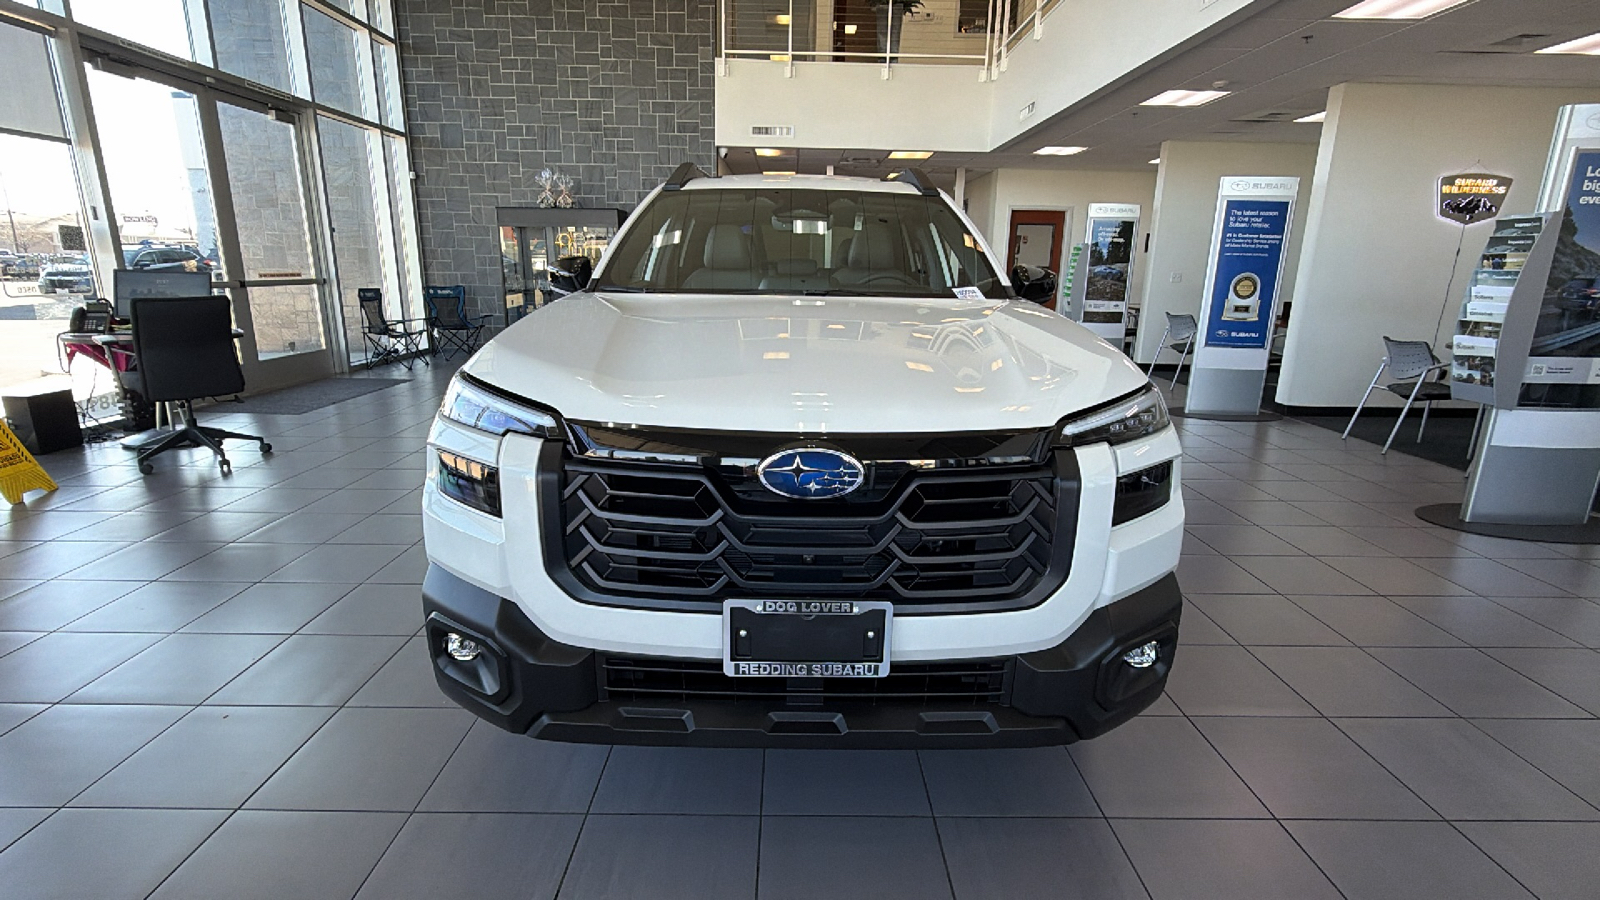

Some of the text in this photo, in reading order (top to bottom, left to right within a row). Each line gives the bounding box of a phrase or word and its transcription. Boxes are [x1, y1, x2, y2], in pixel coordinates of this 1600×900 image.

[1454, 177, 1498, 186] SUBARU
[1251, 182, 1293, 191] SUBARU
[1441, 185, 1507, 194] WILDERNESS
[765, 601, 851, 613] DOG LOVER
[739, 663, 876, 676] REDDING SUBARU
